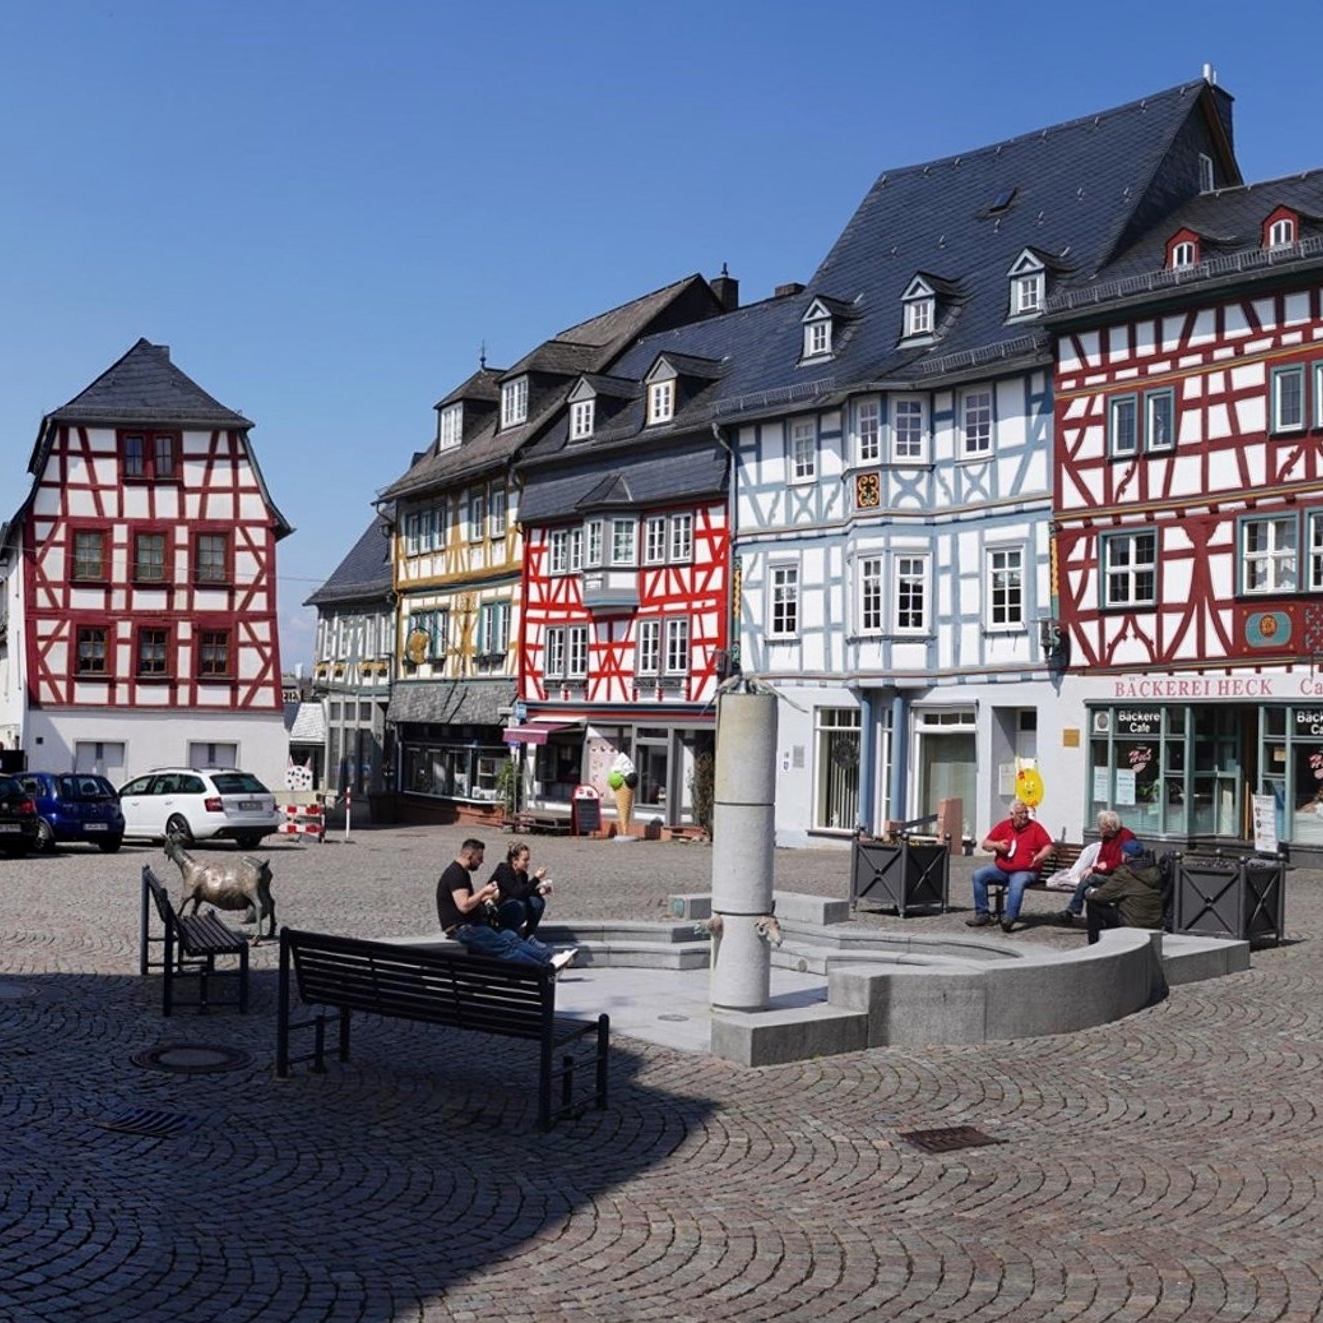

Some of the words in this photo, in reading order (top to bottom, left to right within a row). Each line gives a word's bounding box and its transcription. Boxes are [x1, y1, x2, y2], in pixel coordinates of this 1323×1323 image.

[1115, 677, 1209, 697] BÄCKEREI
[1218, 679, 1273, 696] HECK
[1119, 711, 1161, 721] Bäckere
[1130, 722, 1150, 732] Cafe
